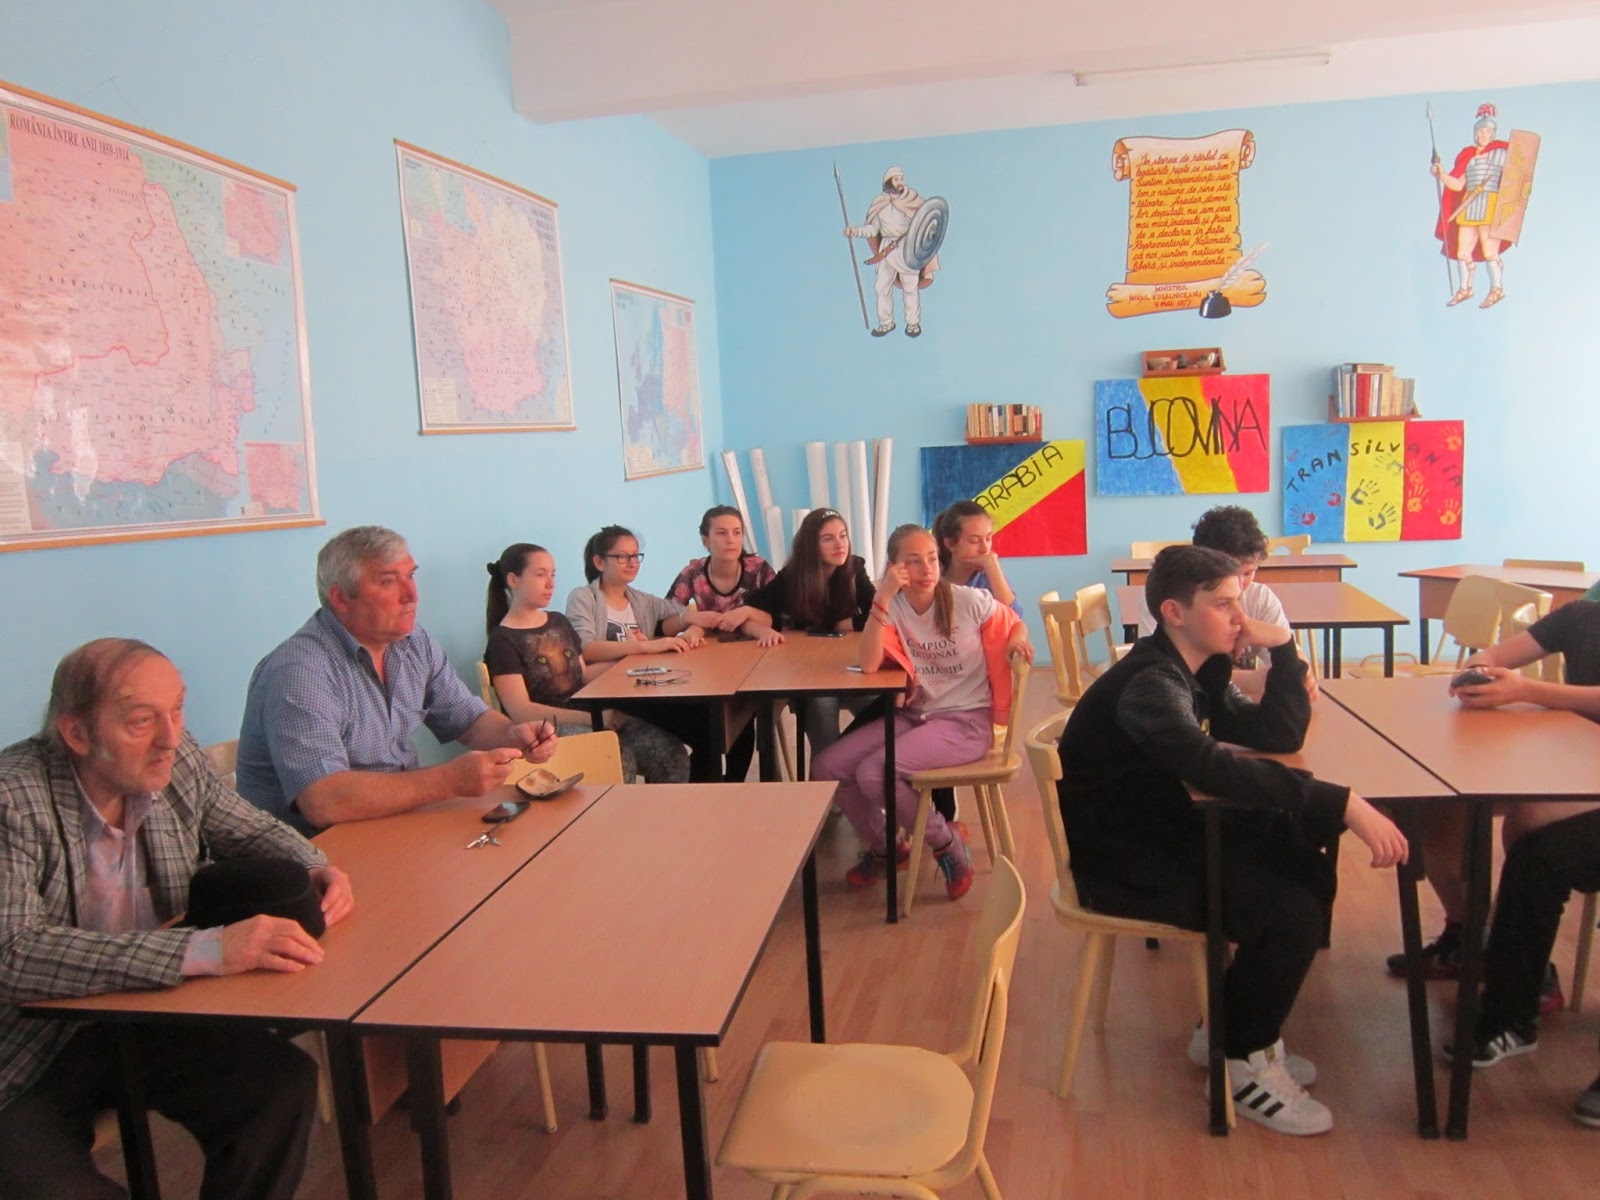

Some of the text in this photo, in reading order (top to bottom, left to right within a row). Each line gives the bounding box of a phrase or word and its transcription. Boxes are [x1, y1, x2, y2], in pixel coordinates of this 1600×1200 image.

[10, 114, 52, 139] ROMÂNIA
[53, 123, 79, 147] ÎNTRE
[81, 138, 98, 152] ANII
[1180, 154, 1190, 163] de
[1219, 153, 1230, 161] cu
[1136, 176, 1163, 187] Suntem
[1186, 186, 1197, 194] de
[1197, 184, 1215, 194] sine
[1136, 208, 1149, 219] lor
[1199, 206, 1214, 214] am
[1214, 205, 1231, 213] cea
[1136, 221, 1149, 229] mai
[1136, 230, 1146, 239] de
[1157, 228, 1192, 239] declara
[1146, 251, 1157, 259] noi
[1158, 249, 1188, 261] suntem
[1155, 284, 1188, 293] MINISTRUL
[1129, 294, 1150, 303] MIHAIL
[1106, 396, 1268, 460] BUCOVINA
